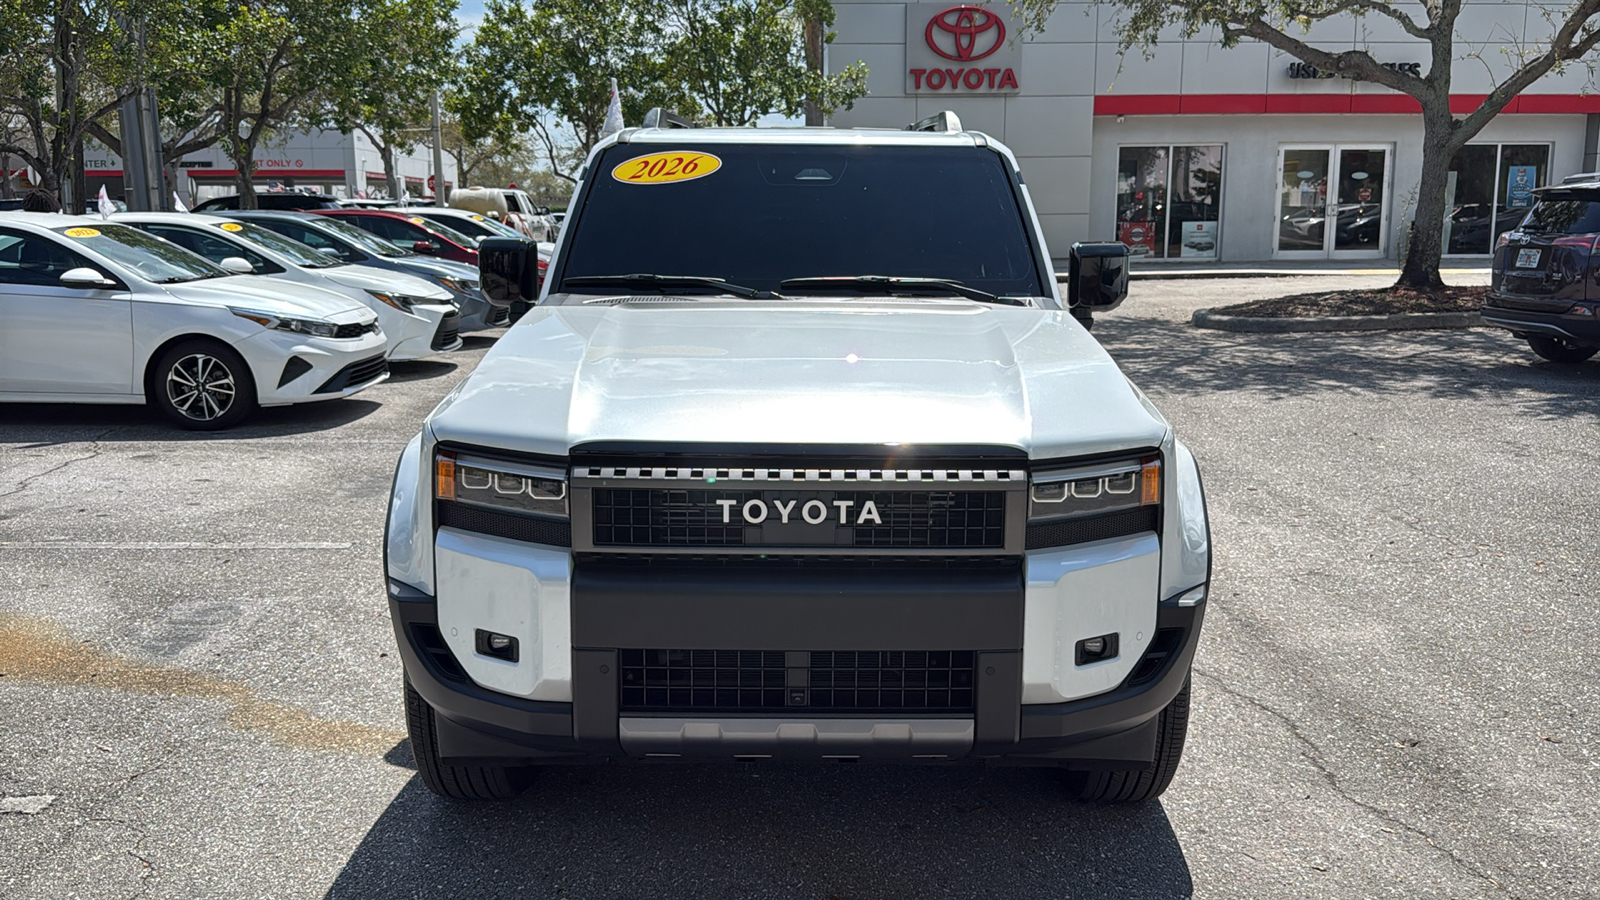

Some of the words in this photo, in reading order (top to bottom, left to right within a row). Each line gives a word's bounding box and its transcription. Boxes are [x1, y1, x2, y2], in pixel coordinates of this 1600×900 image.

[909, 68, 1019, 90] TOYOTA
[84, 159, 107, 168] NTER
[266, 159, 292, 168] ONLY
[628, 156, 704, 180] 2026
[716, 499, 882, 525] TOYOTA
